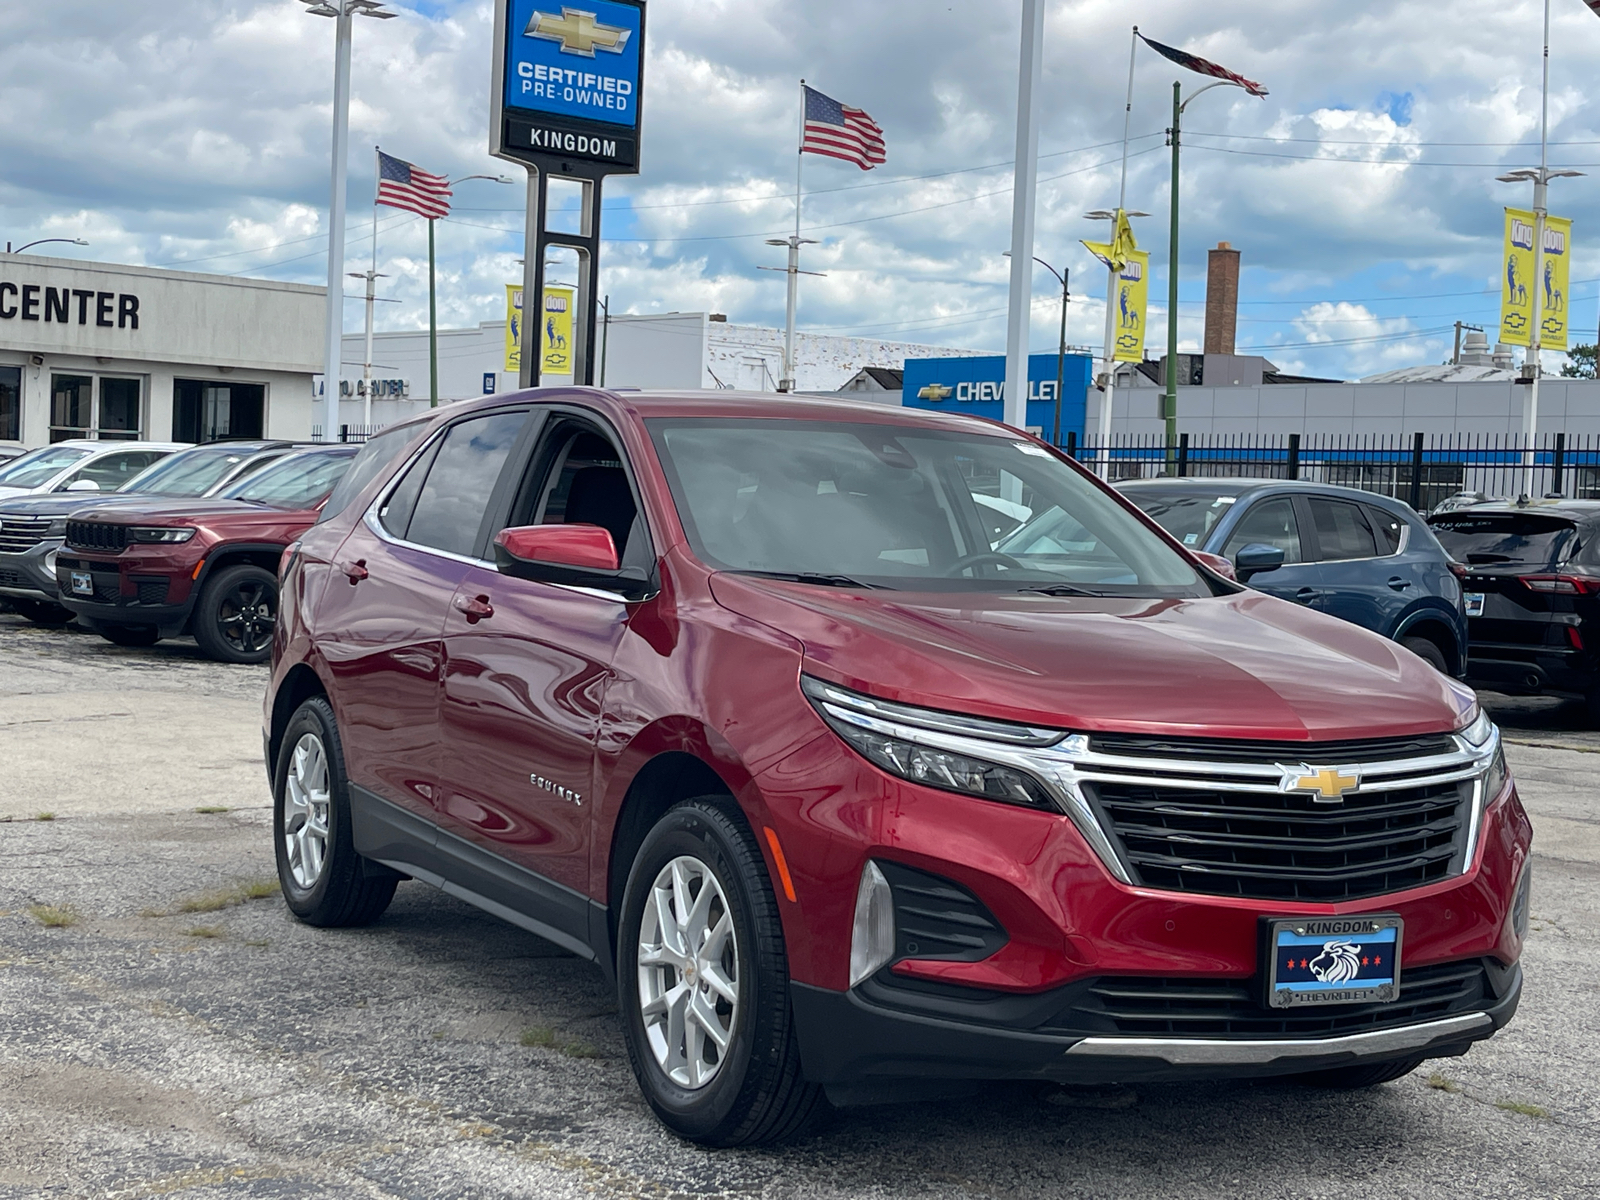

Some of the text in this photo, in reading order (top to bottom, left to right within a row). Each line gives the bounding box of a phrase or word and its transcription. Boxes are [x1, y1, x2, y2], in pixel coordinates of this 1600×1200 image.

[517, 61, 632, 96] CERTIFIED
[522, 80, 628, 111] PRE-OWNED
[530, 128, 616, 157] KINGDOM
[1511, 219, 1533, 249] King
[1543, 226, 1564, 253] dom
[0, 281, 140, 330] CENTER
[546, 294, 567, 312] dom
[357, 380, 409, 397] CNTER
[956, 380, 1058, 402] CHEVLET
[530, 773, 583, 806] EQUINOX
[1306, 920, 1374, 934] KINGDOM
[1300, 990, 1369, 1004] CHEVROLET
